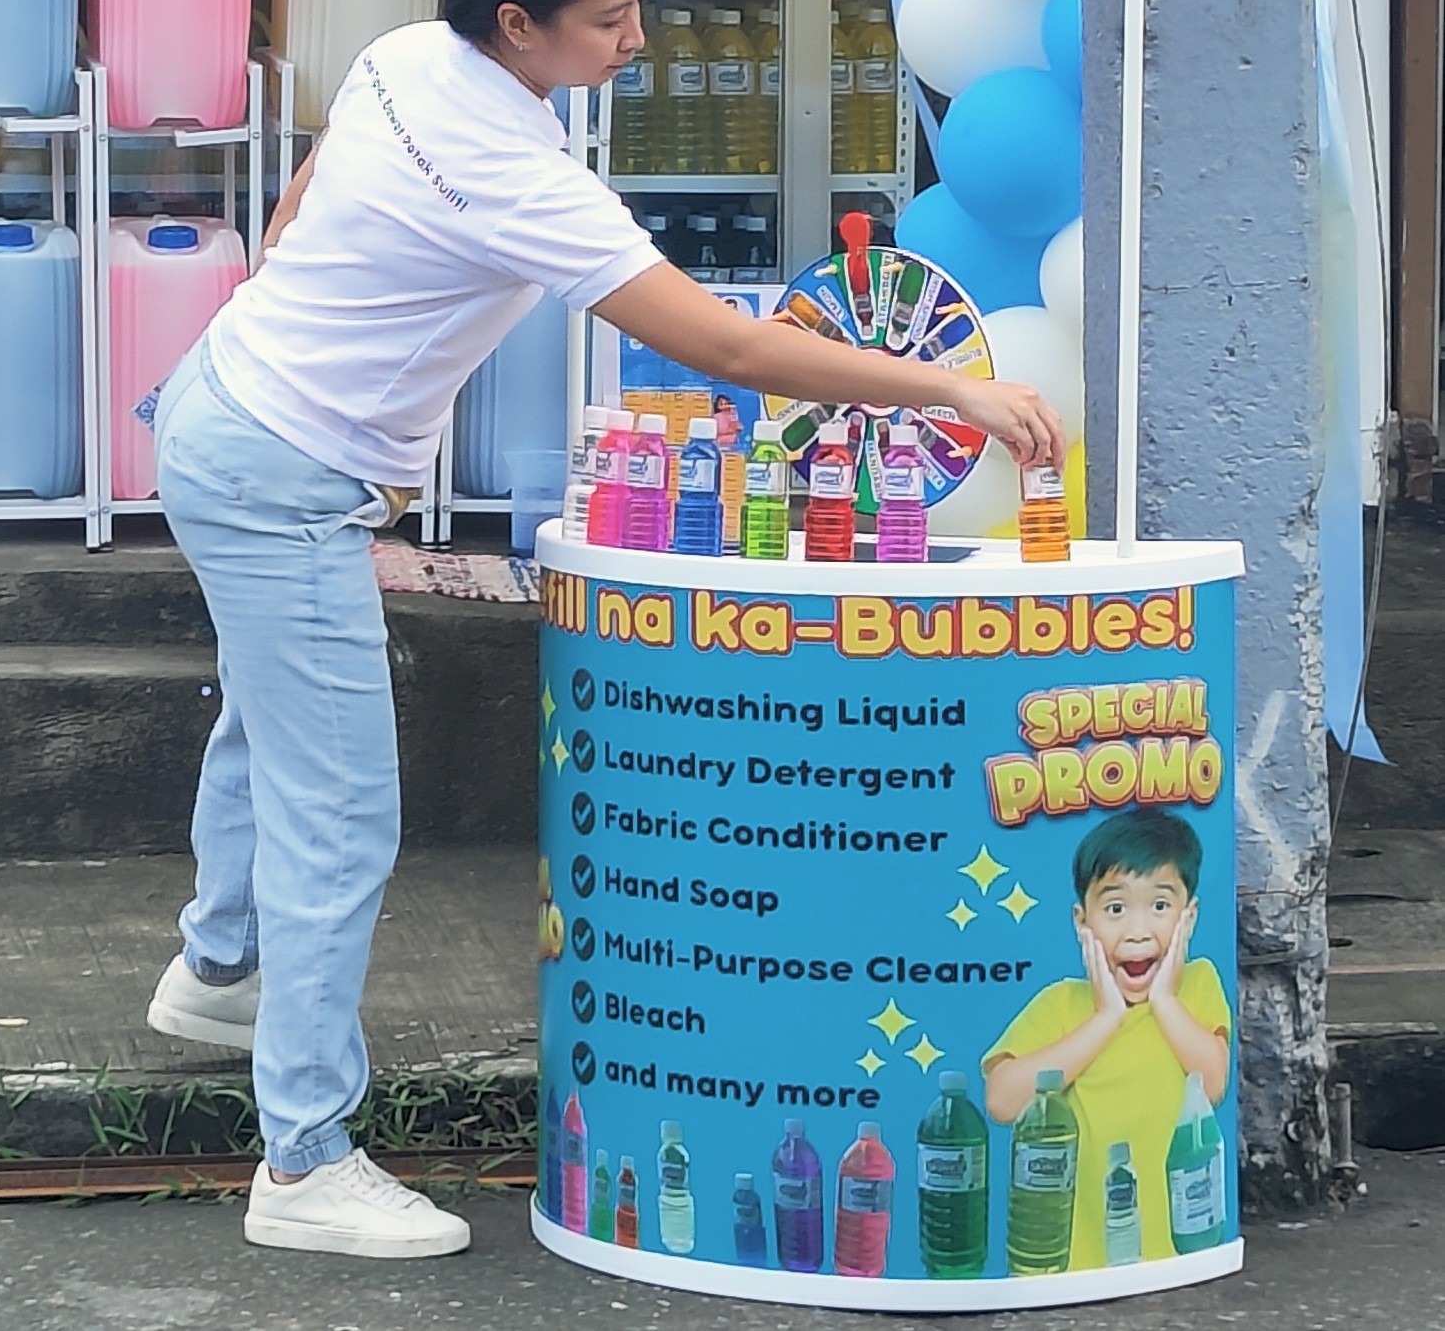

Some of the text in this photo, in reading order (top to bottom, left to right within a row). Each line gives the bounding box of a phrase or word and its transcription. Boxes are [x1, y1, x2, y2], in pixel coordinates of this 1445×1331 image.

[538, 568, 1197, 660] fill na ka-Bubbles!
[603, 679, 968, 731] Dishwashing Liquid
[1018, 677, 1210, 746] SPECIAL
[603, 740, 957, 796] Laundry Detergent
[985, 736, 1225, 827] PROMO
[603, 803, 949, 855] Fabric Conditioner
[603, 867, 780, 917] Hand Soap
[603, 931, 1034, 985] Multi-Purpose Cleaner
[604, 995, 707, 1036] Bleach
[604, 1059, 881, 1110] and many more
